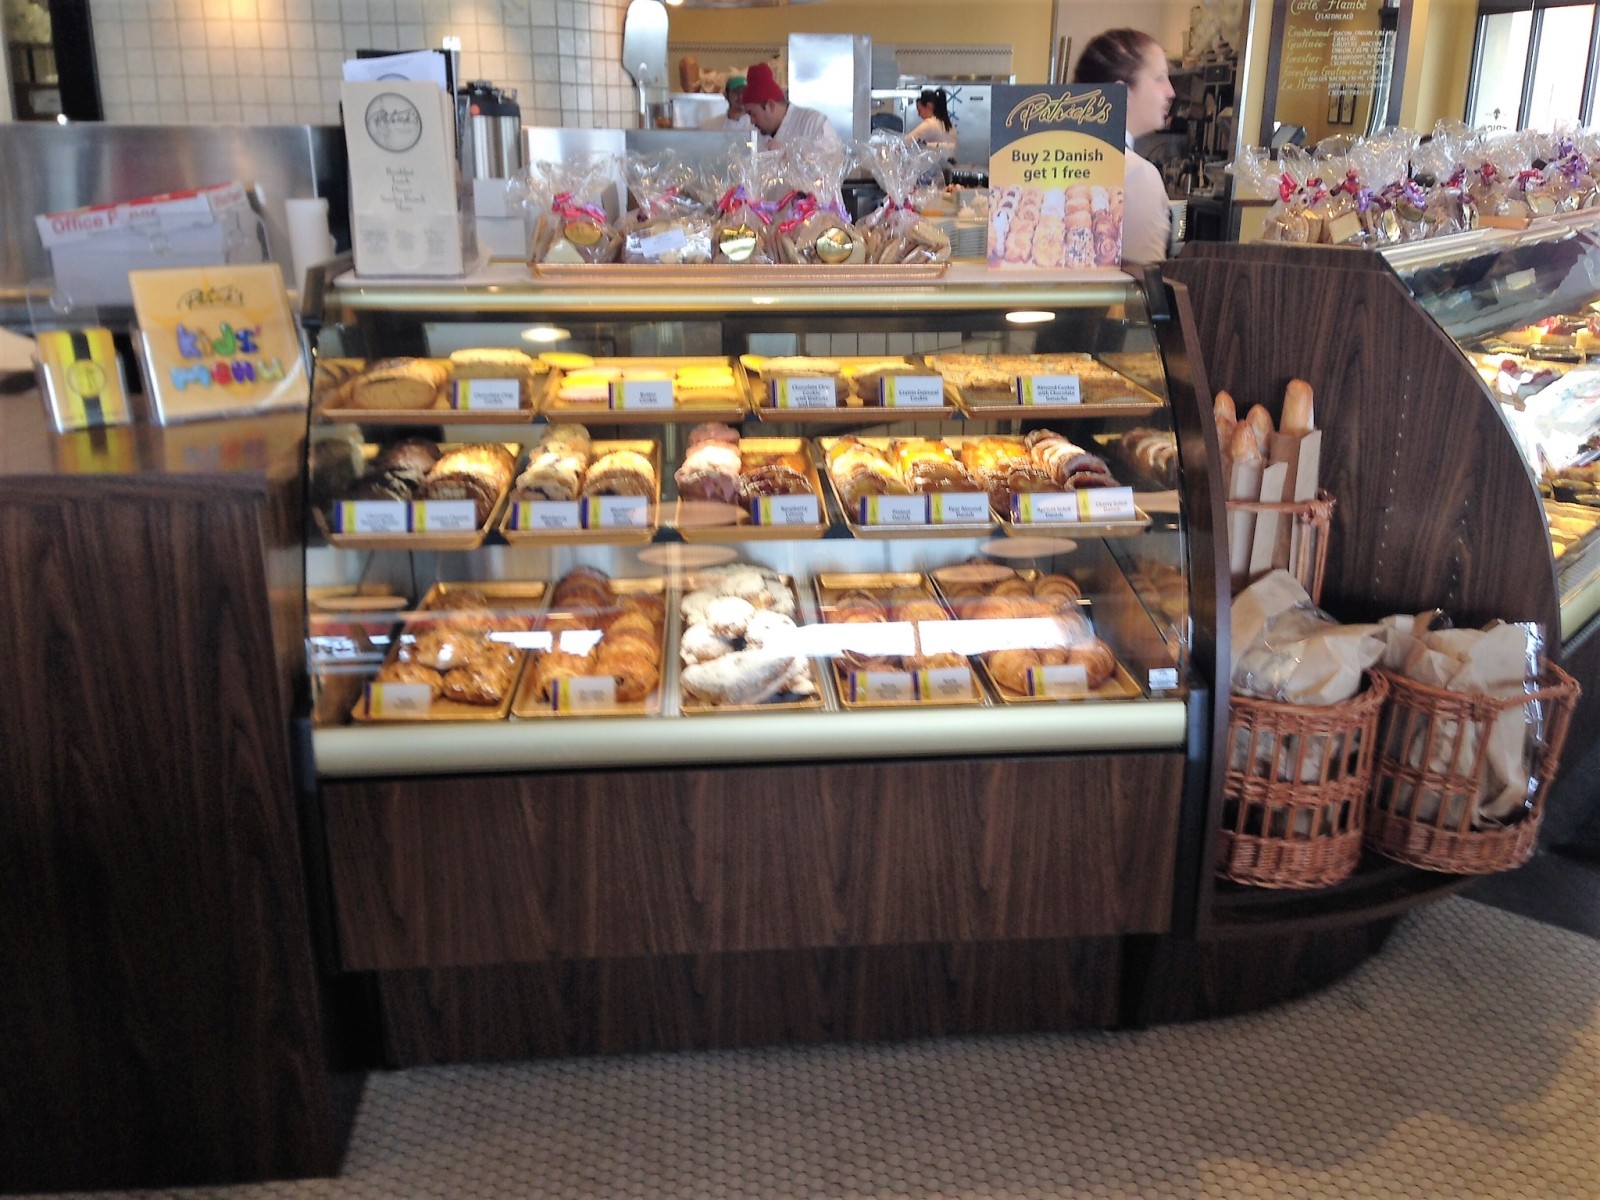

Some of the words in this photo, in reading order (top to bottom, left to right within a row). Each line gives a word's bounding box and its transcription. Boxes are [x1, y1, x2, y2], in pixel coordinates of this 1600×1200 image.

[1006, 89, 1112, 131] Patrick's
[1011, 150, 1038, 165] Buy
[1042, 150, 1050, 162] 2
[1054, 148, 1103, 162] Danish
[1023, 167, 1047, 182] get
[1051, 167, 1057, 178] 1
[1062, 166, 1091, 178] free
[51, 213, 104, 235] Office
